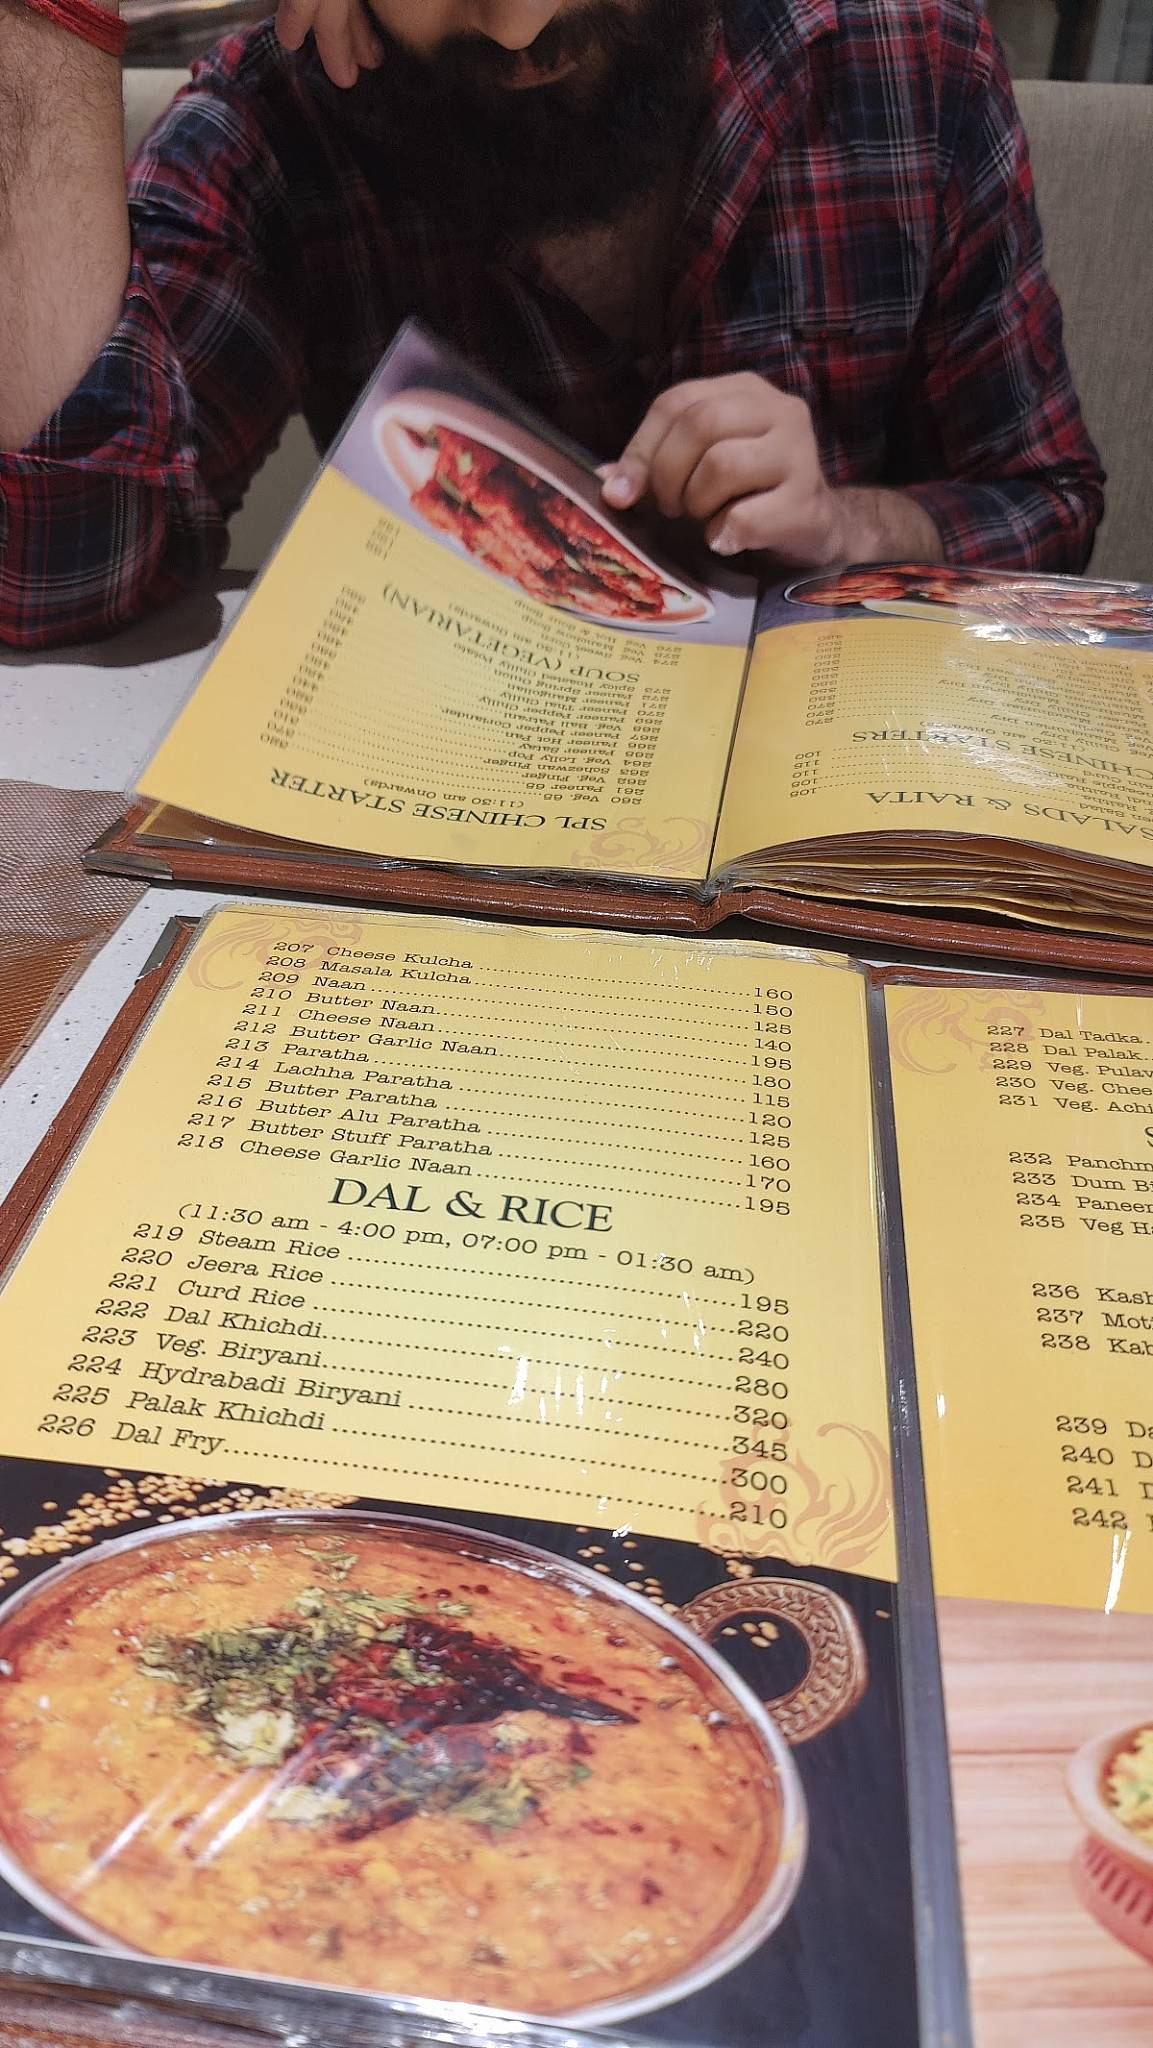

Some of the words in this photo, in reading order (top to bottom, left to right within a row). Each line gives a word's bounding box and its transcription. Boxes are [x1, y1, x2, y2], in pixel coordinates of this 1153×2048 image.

[382, 583, 562, 672] (VEGETARIAN)
[570, 667, 640, 683] SOUP
[1020, 744, 1153, 779] CHINESE
[270, 768, 405, 814] STARTER
[364, 778, 436, 799] Onwards)
[443, 793, 466, 802] am
[865, 791, 975, 807] RAITA
[983, 797, 1011, 811] &
[412, 803, 546, 828] CHINESE
[555, 816, 607, 830] SPL
[1023, 803, 1153, 841] SALADS
[265, 955, 306, 969] 208
[321, 960, 393, 977] Masala
[399, 968, 472, 985] Kulcha
[753, 1003, 793, 1018] 150
[273, 941, 315, 953] 207
[327, 947, 396, 962] Cheese
[402, 953, 473, 969] Kulcha
[755, 987, 793, 1001] 160
[251, 987, 292, 1001] 210
[304, 992, 374, 1008] Butter
[380, 999, 436, 1015] Naan
[755, 1038, 791, 1052] 140
[258, 971, 300, 984] 209
[311, 976, 366, 991] Naan
[754, 1021, 792, 1035] 125
[242, 1003, 281, 1017] 211
[298, 1008, 372, 1026] Cheese
[378, 1016, 435, 1032] Naan
[753, 1055, 792, 1071] 195
[987, 1025, 1024, 1036] 227
[1039, 1028, 1073, 1040] Dal
[1079, 1030, 1143, 1044] Tadka
[990, 1042, 1028, 1053] 228
[1043, 1045, 1077, 1056] Dal
[1084, 1047, 1143, 1061] Palak
[225, 1038, 270, 1052] 213
[281, 1043, 370, 1063] Paratha
[753, 1092, 790, 1108] 115
[233, 1020, 277, 1035] 212
[289, 1025, 361, 1043] Butter
[368, 1033, 433, 1050] Garlic
[440, 1040, 497, 1056] Naan
[752, 1074, 791, 1090] 180
[993, 1059, 1031, 1070] 229
[1045, 1062, 1089, 1076] Veg.
[215, 1055, 259, 1071] 214
[273, 1061, 355, 1080] Lachha
[362, 1070, 453, 1090] Paratha
[749, 1111, 792, 1129] 120
[996, 1076, 1035, 1088] 230
[1049, 1079, 1093, 1094] Veg.
[999, 1094, 1038, 1106] 231
[1053, 1098, 1098, 1112] Veg.
[206, 1074, 252, 1090] 215
[264, 1079, 339, 1098] Butter
[345, 1088, 438, 1109] Paratha
[750, 1131, 790, 1149] 125
[197, 1093, 243, 1109] 216
[256, 1099, 332, 1118] Butter
[337, 1108, 379, 1123] Alu
[386, 1112, 481, 1133] Paratha
[749, 1153, 790, 1172] 160
[187, 1112, 235, 1128] 217
[247, 1119, 324, 1139] Butter
[330, 1128, 392, 1146] Stuff
[397, 1134, 493, 1156] Paratha
[746, 1174, 791, 1193] 170
[1009, 1152, 1052, 1165] 232
[177, 1133, 224, 1149] 218
[240, 1140, 321, 1161] Cheese
[329, 1149, 401, 1169] Garlic
[408, 1157, 472, 1176] Naan
[745, 1196, 790, 1216] 195
[1013, 1172, 1056, 1185] 233
[1071, 1175, 1125, 1190] Dum
[328, 1177, 431, 1213] DAL
[445, 1190, 486, 1219] &
[497, 1194, 613, 1232] RICE
[1016, 1193, 1061, 1207] 234
[1020, 1214, 1065, 1229] 235
[1079, 1217, 1124, 1235] Veg
[178, 1203, 263, 1225] (11:30
[271, 1216, 309, 1231] am
[337, 1220, 395, 1239] 4:00
[403, 1230, 451, 1249] pm,
[462, 1233, 538, 1254] 07:00
[546, 1245, 588, 1261] pm
[617, 1250, 693, 1274] 01:30
[703, 1265, 754, 1286] am)
[132, 1223, 184, 1242] 219
[198, 1229, 276, 1252] Steam
[285, 1239, 340, 1259] Rice
[741, 1293, 789, 1316] 195
[121, 1247, 173, 1266] 220
[187, 1254, 259, 1277] Jeera
[267, 1263, 323, 1283] Rice
[737, 1319, 789, 1343] 220
[1032, 1283, 1079, 1299] 236
[108, 1272, 157, 1292] 221
[178, 1279, 242, 1301] Curd
[248, 1287, 305, 1308] Rice
[738, 1347, 789, 1370] 240
[1037, 1308, 1083, 1324] 237
[95, 1298, 149, 1319] 222
[163, 1305, 211, 1326] Dal
[217, 1311, 322, 1339] Khichdi
[735, 1375, 788, 1400] 280
[1042, 1333, 1090, 1351] 238
[81, 1325, 138, 1346] 223
[156, 1332, 206, 1358] Veg.
[217, 1340, 322, 1368] Biryani
[733, 1405, 788, 1430] 320
[67, 1353, 122, 1376] 224
[138, 1361, 286, 1394] Hydrabadi
[294, 1378, 401, 1408] Biryani
[732, 1435, 788, 1462] 345
[1056, 1416, 1107, 1434] 239
[52, 1383, 110, 1406] 225
[125, 1390, 207, 1417] Palak
[214, 1400, 325, 1431] Khichdi
[730, 1467, 787, 1495] 300
[1061, 1445, 1113, 1465] 240
[37, 1413, 96, 1437] 226
[111, 1421, 163, 1445] Dal
[169, 1428, 226, 1456] Fry
[729, 1501, 787, 1529] 210
[1066, 1476, 1119, 1496] 241
[1072, 1508, 1128, 1530] 242
